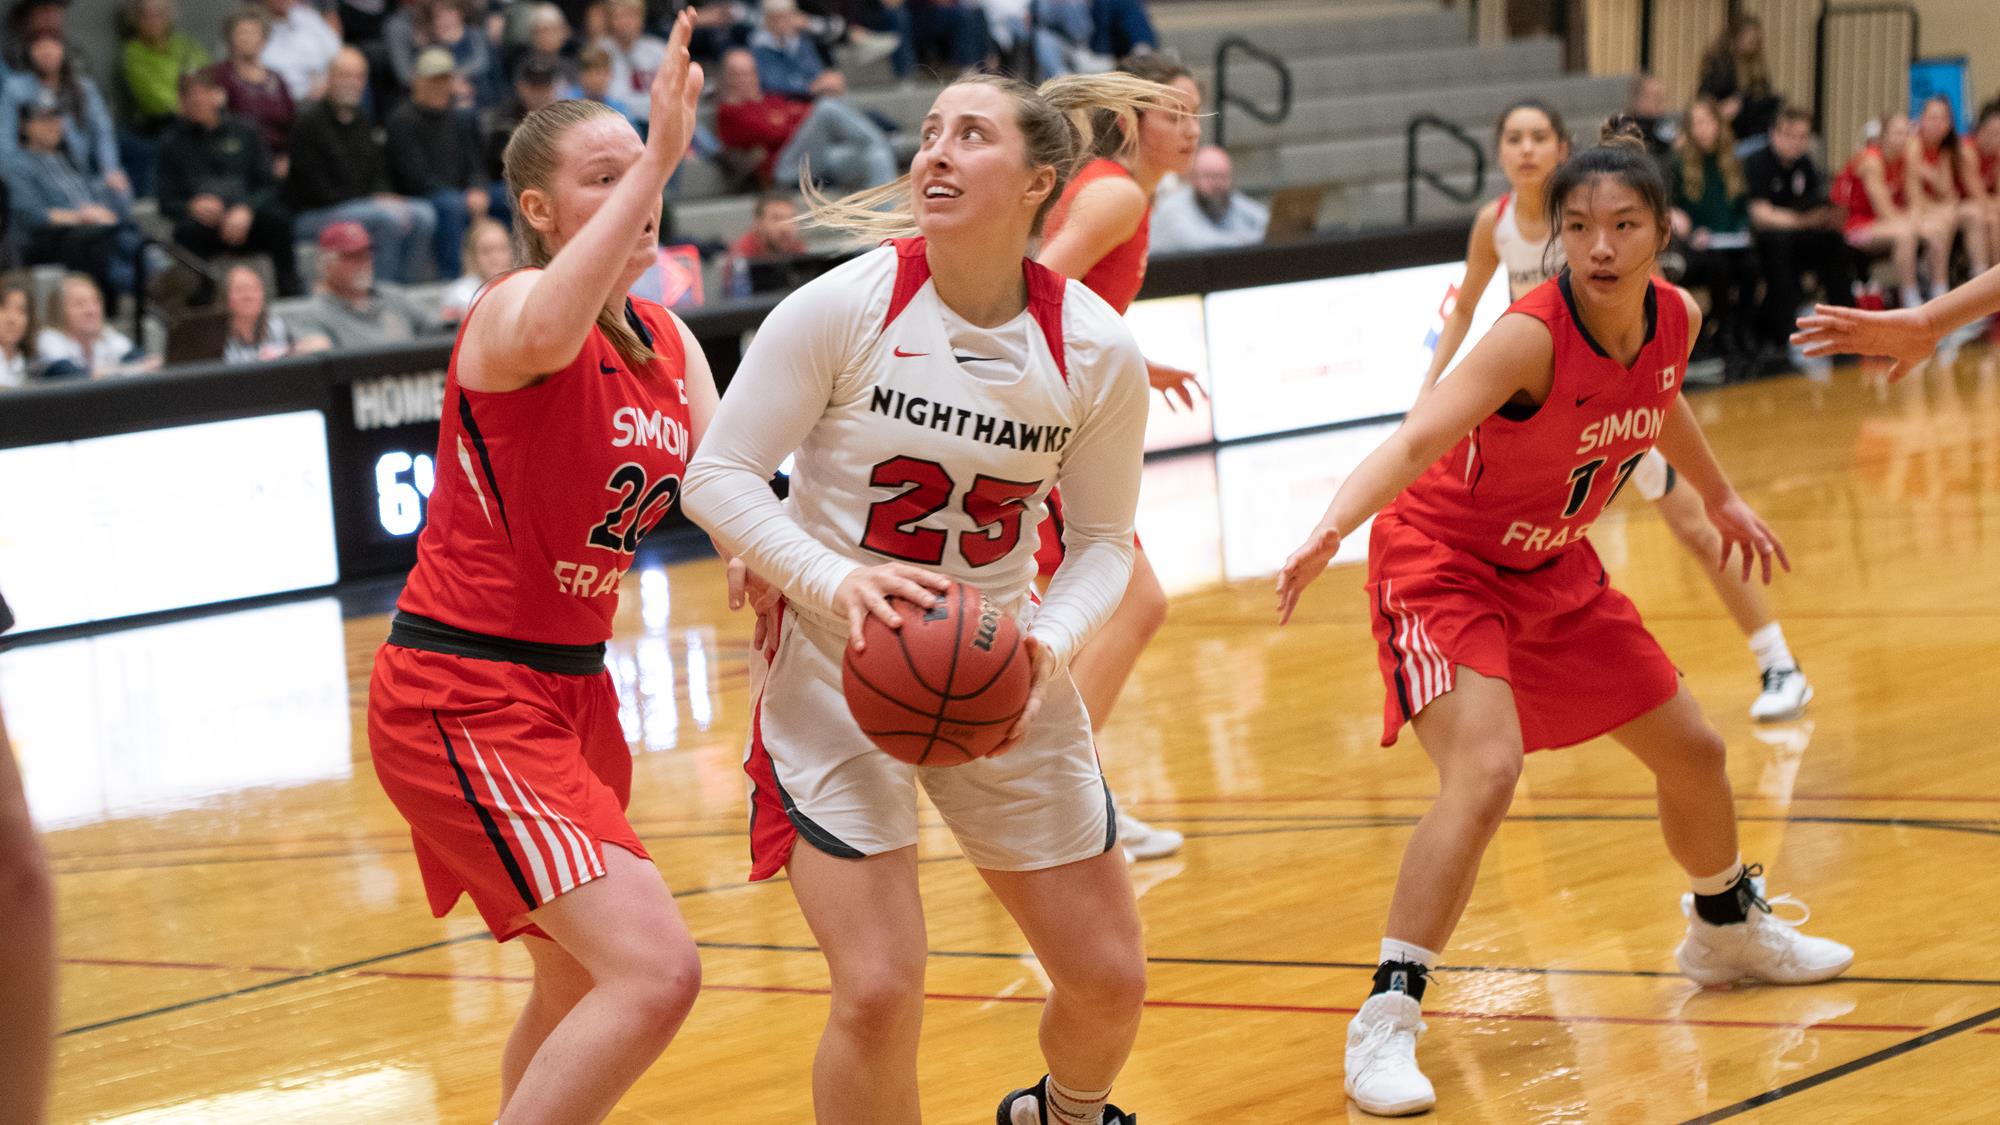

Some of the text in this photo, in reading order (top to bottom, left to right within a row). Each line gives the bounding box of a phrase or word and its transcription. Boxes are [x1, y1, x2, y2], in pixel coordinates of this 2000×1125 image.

[353, 371, 446, 430] HOME
[869, 385, 1072, 453] NIGHTHAWKS
[1576, 406, 1665, 455] SIMON
[611, 406, 689, 462] SIMON
[585, 461, 681, 556] 20
[859, 454, 1044, 568] 25
